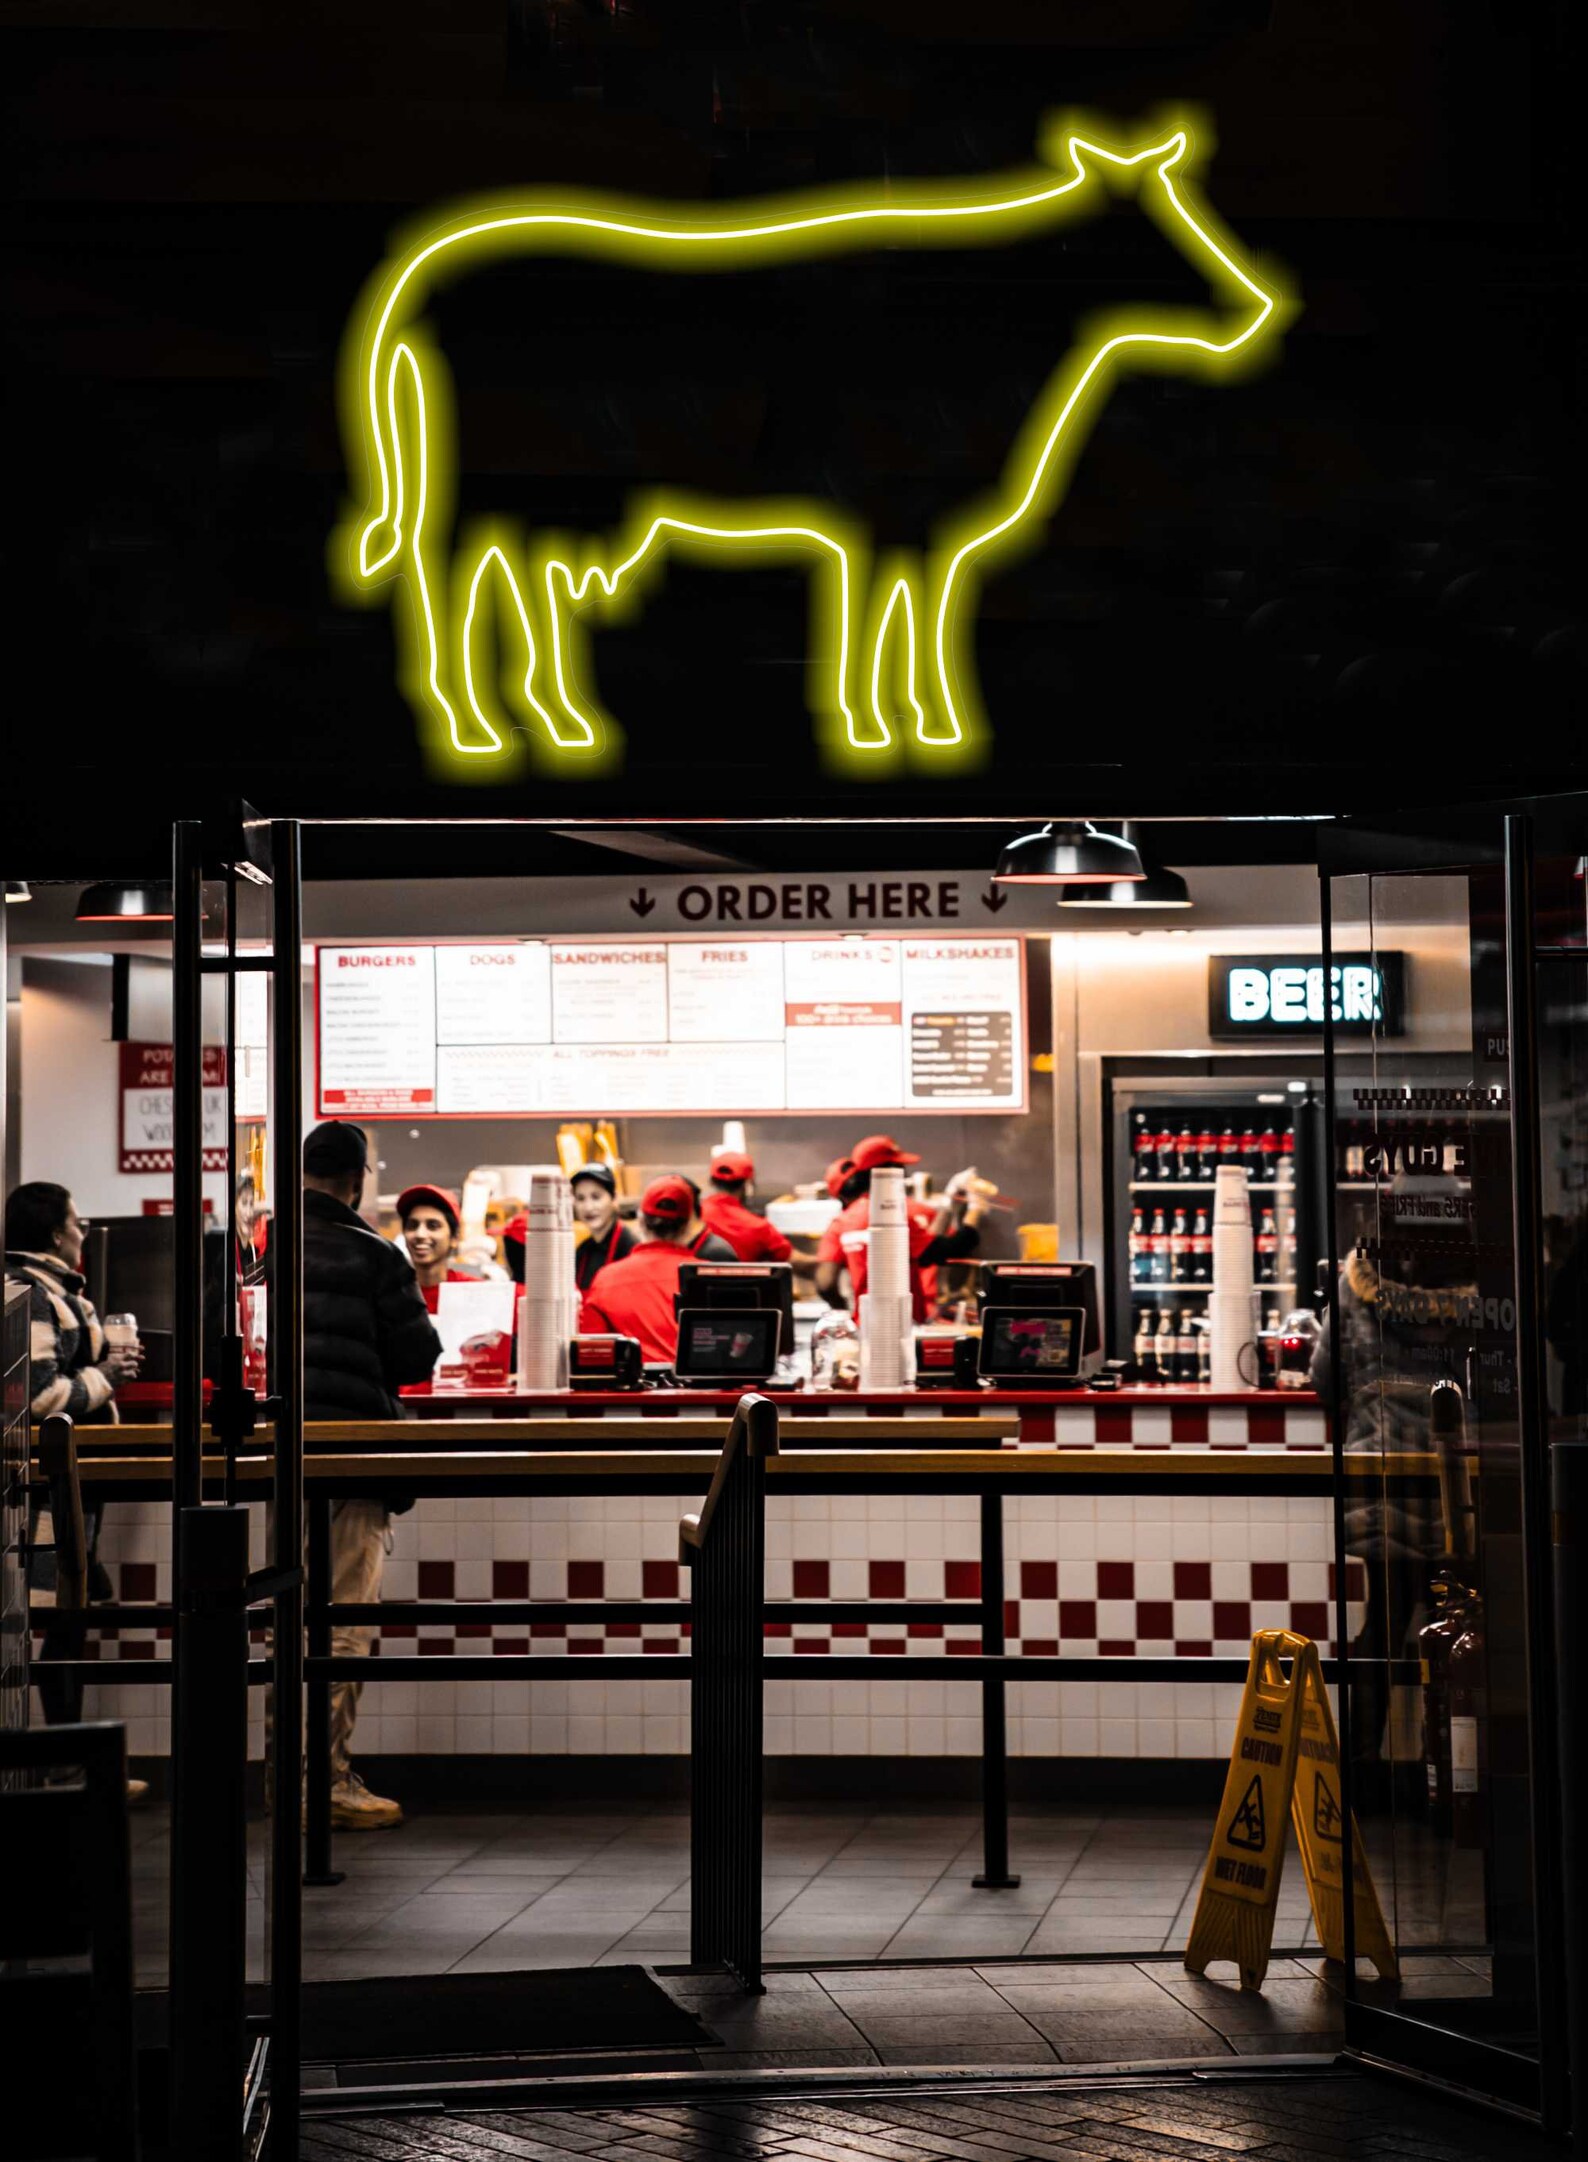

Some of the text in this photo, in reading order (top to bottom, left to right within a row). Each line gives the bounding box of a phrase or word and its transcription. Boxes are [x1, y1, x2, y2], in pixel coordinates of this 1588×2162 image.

[678, 881, 960, 920] ORDER HERE
[470, 954, 516, 966] DOGS
[553, 950, 666, 965] SANDWICHES
[701, 949, 749, 963] FRIES
[811, 949, 873, 962] DRINKS
[906, 946, 1015, 961] MILKSHAKES
[337, 955, 417, 968] BURGERS
[1228, 966, 1382, 1023] BEER
[1215, 1855, 1267, 1890] WET FLOOR
